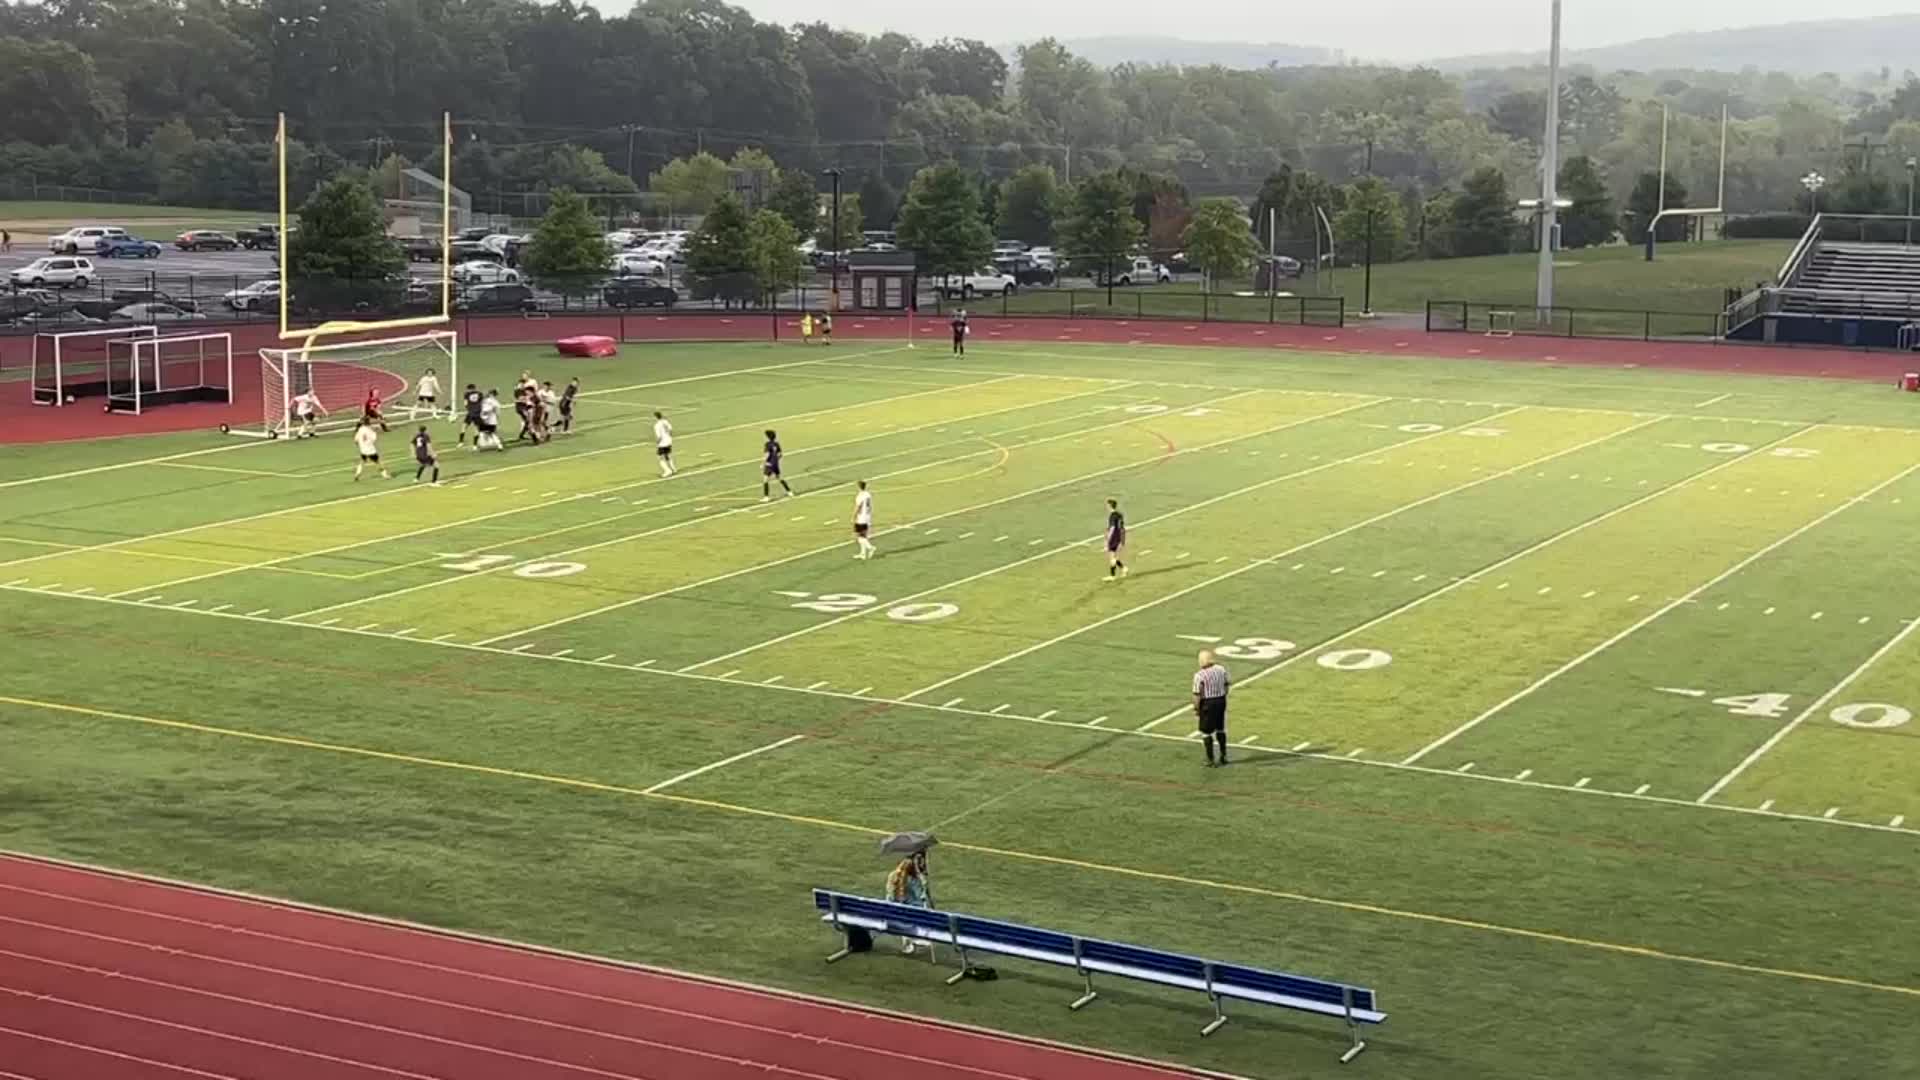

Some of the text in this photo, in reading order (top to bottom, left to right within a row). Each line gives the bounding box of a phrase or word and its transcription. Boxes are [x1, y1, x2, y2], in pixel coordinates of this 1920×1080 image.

[790, 593, 959, 620] 20
[1214, 637, 1392, 669] 30
[1712, 693, 1911, 727] 40
